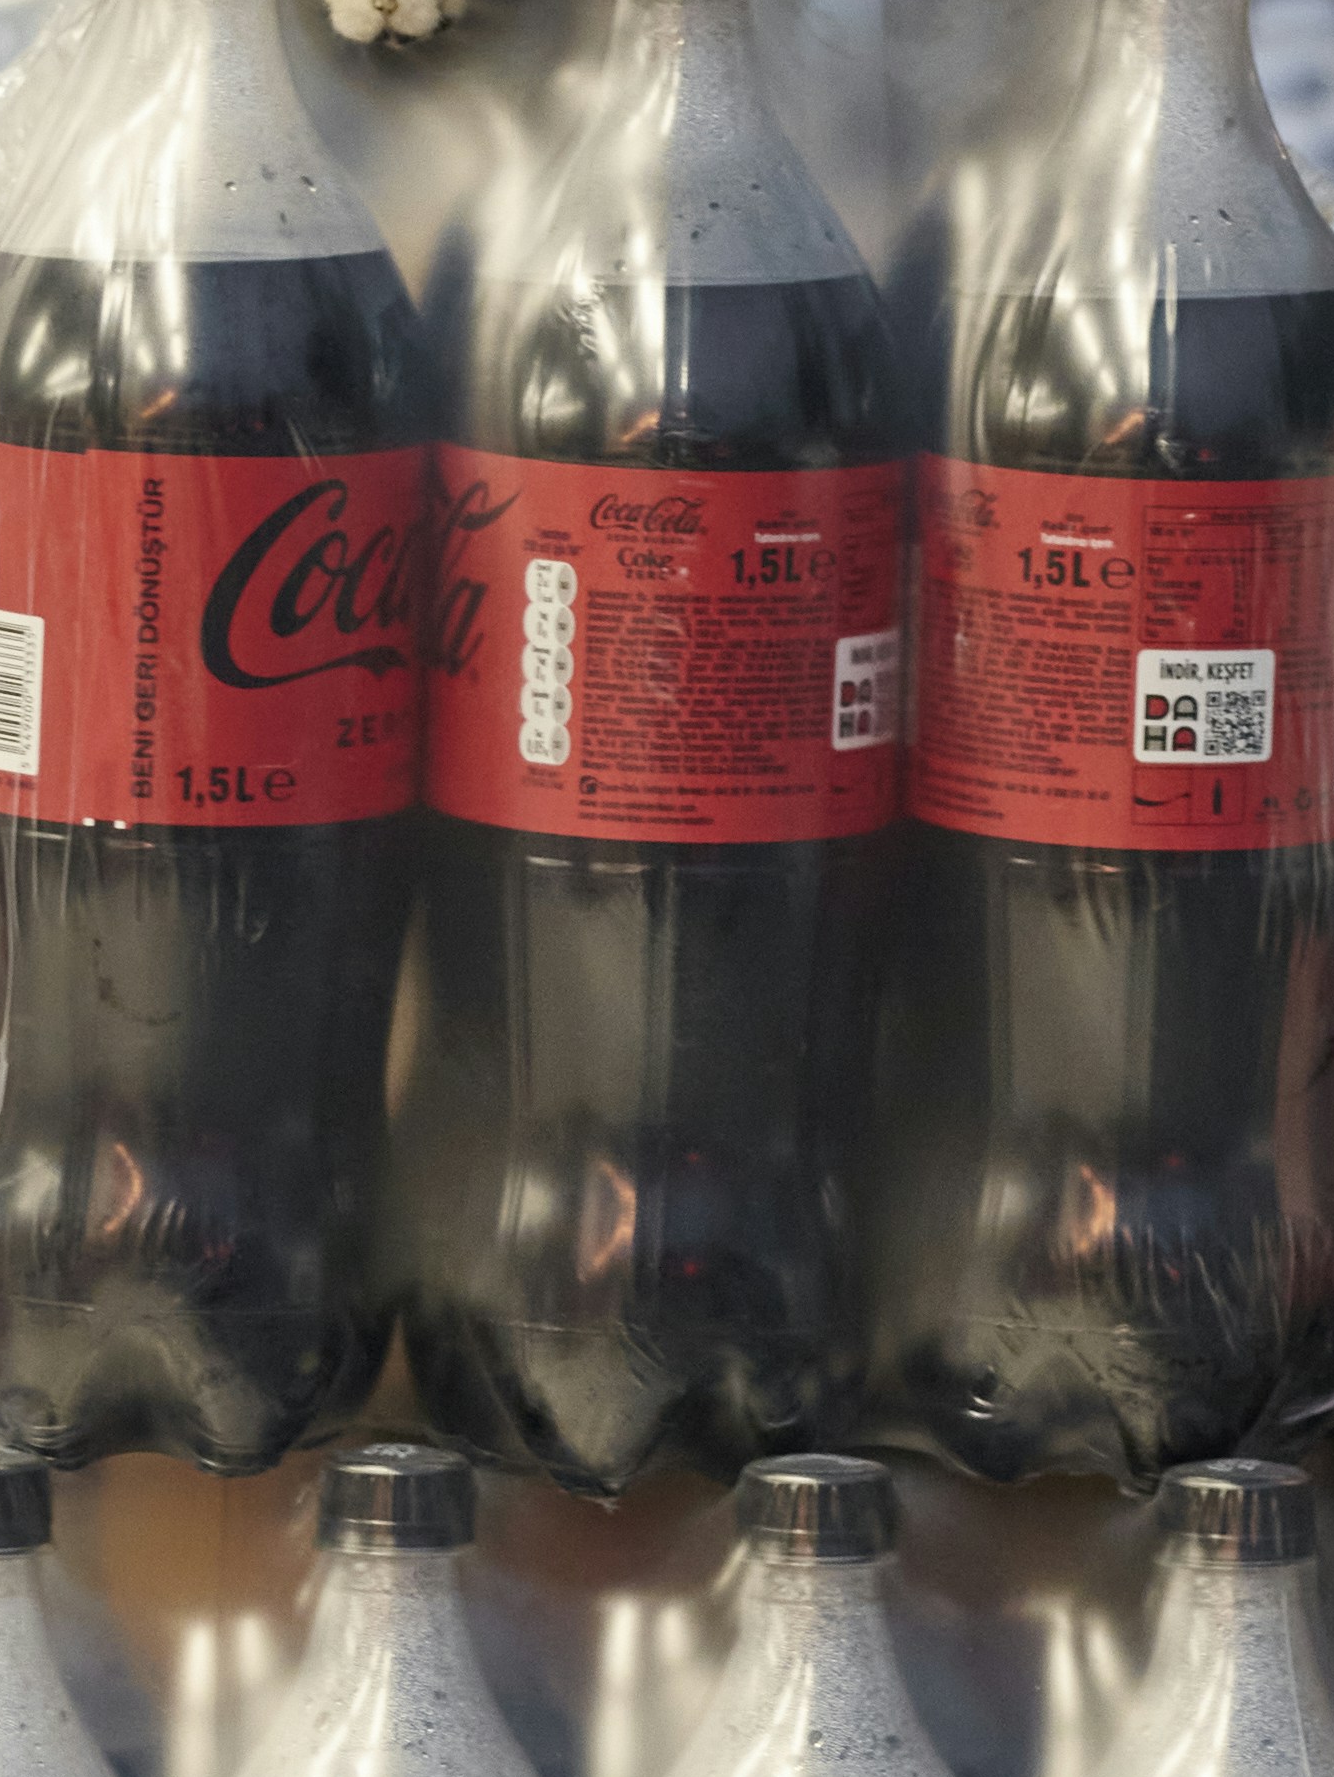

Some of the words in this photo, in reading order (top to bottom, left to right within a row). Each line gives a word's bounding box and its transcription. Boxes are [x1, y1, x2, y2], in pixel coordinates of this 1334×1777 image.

[729, 545, 802, 589] 1,5L
[1018, 546, 1091, 590] 1,5L
[1206, 661, 1255, 685] KEŞFET
[174, 765, 255, 812] 1,5L
